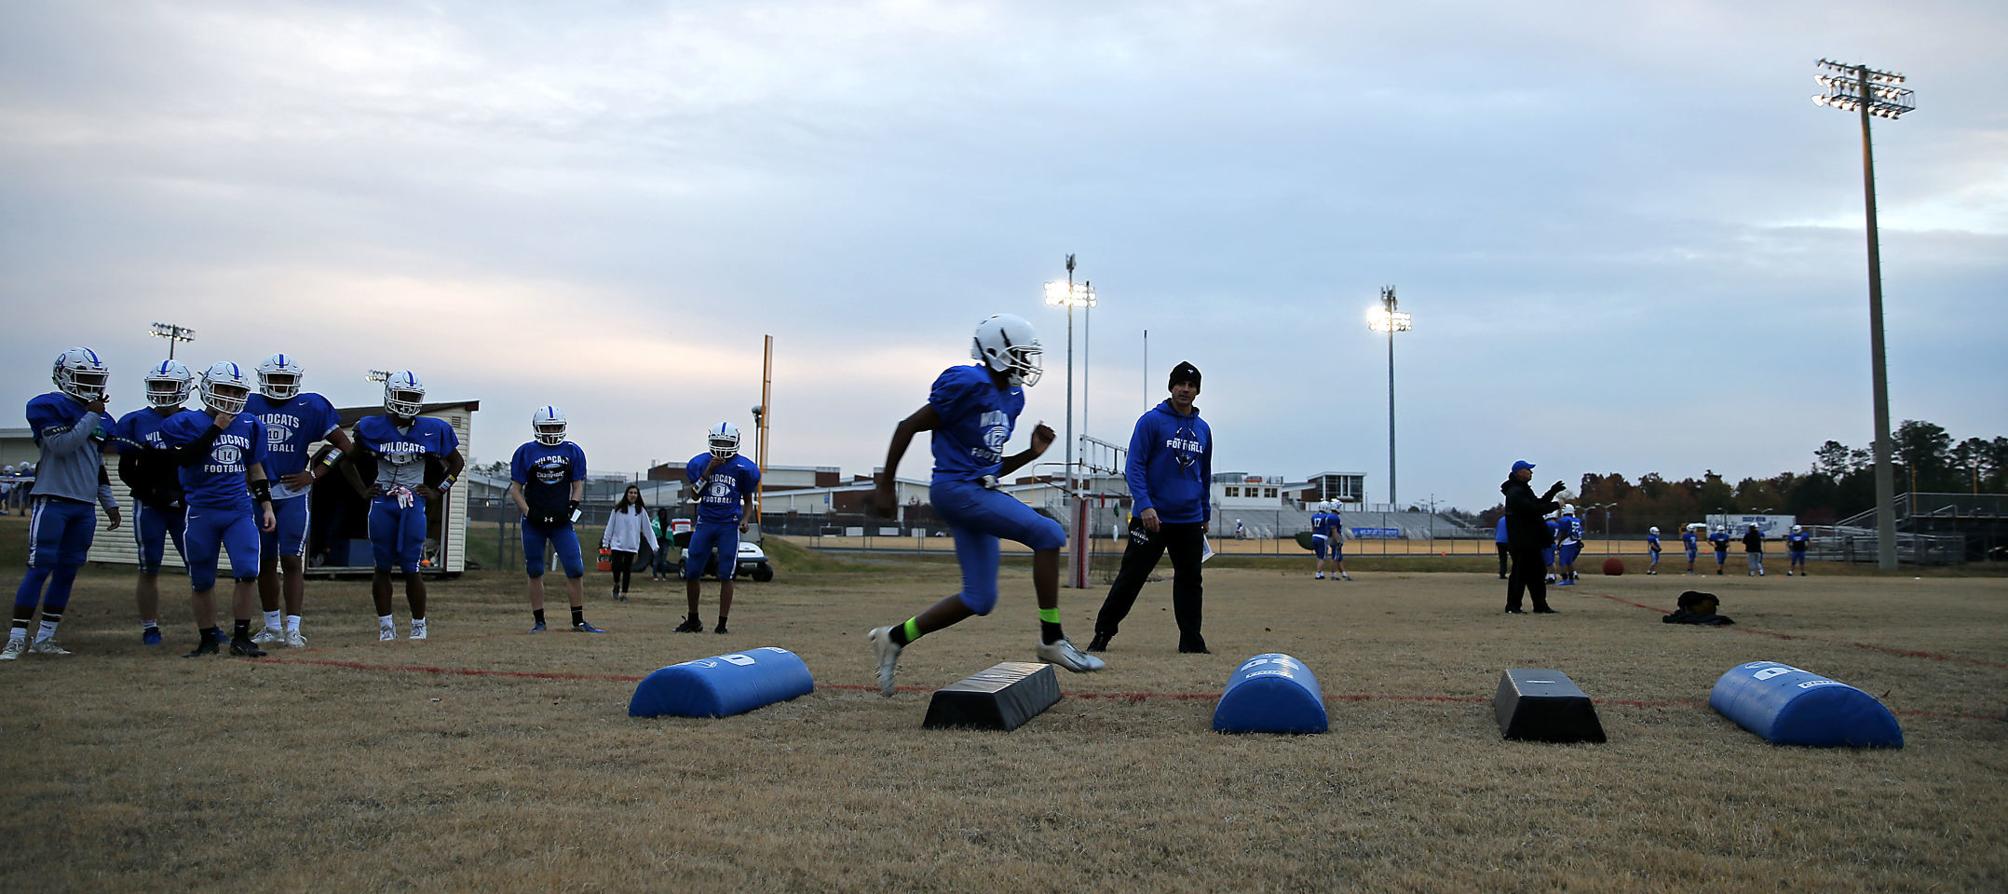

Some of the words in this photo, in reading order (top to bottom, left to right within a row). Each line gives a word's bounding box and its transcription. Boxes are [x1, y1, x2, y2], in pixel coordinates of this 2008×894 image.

[257, 413, 300, 428] ILDCATS
[212, 434, 250, 449] ILDCATS
[267, 443, 295, 452] TBALL
[380, 441, 426, 454] WILDCATS
[223, 451, 232, 461] 14
[400, 454, 405, 462] 3
[204, 464, 246, 473] FOOTBALL
[709, 473, 736, 487] ILDCATS
[703, 495, 732, 504] FOOTBALL
[1314, 517, 1322, 528] 17
